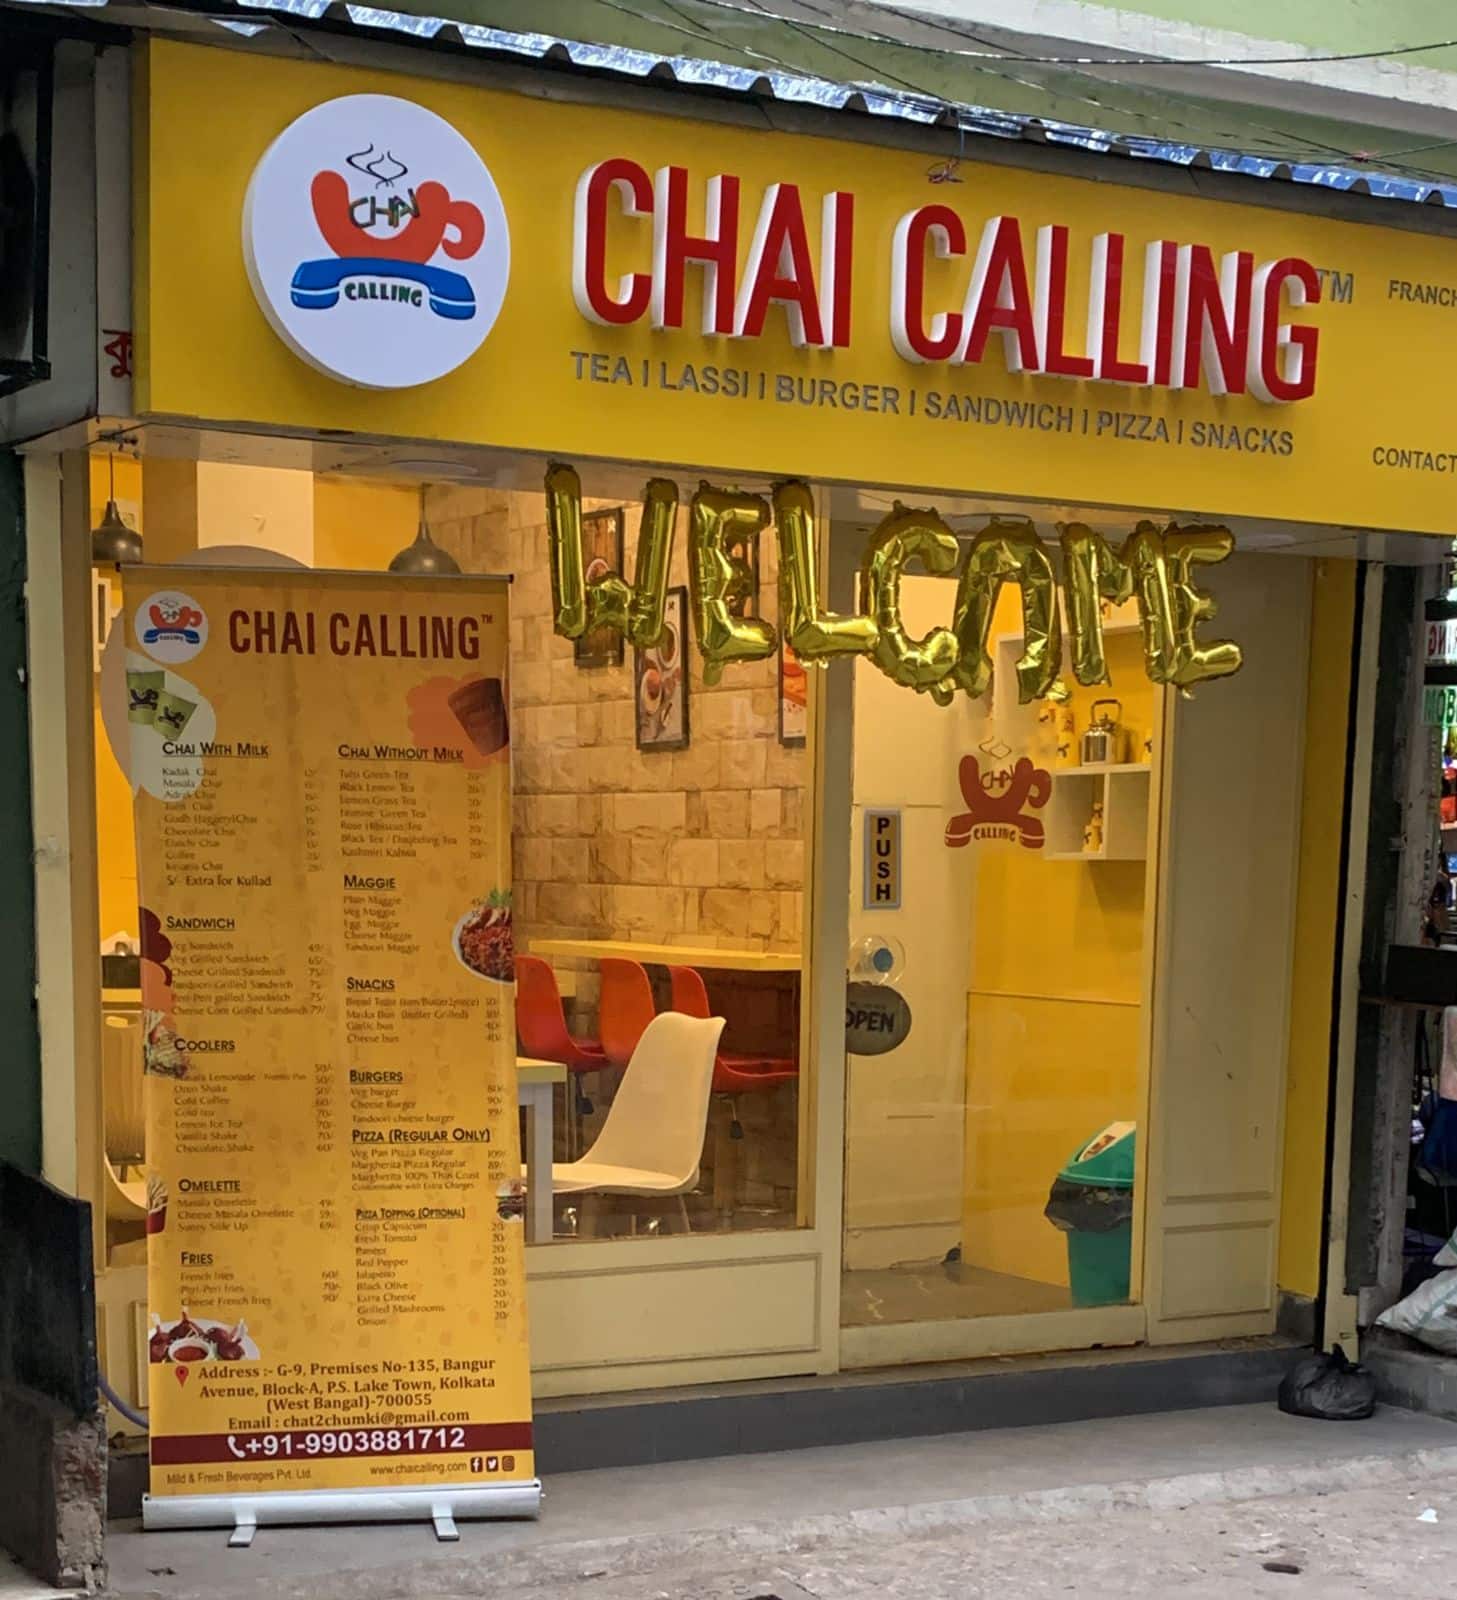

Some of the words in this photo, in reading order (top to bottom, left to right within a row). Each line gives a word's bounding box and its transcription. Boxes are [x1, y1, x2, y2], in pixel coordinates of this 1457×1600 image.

[348, 187, 420, 229] CHAI
[572, 158, 854, 352] CHAI
[890, 204, 1321, 405] CALLING
[1316, 267, 1354, 305] TM
[344, 281, 423, 308] CALLING
[570, 351, 632, 385] TEA
[660, 364, 748, 398] LASSI
[775, 377, 899, 415] BURGER
[924, 396, 1073, 433] SANDWICH
[1097, 409, 1169, 444] PIZZA
[1190, 423, 1294, 457] SNACKS
[544, 461, 1242, 704] WELCOME
[228, 609, 316, 656] CHAI
[329, 612, 481, 660] CALLING
[161, 740, 196, 756] CHAI
[199, 741, 232, 756] WITH
[236, 742, 269, 758] MILK
[338, 743, 371, 759] CHAI
[374, 744, 430, 760] WITHOUT
[433, 746, 465, 762] MILK
[973, 826, 1017, 842] CALLING
[875, 816, 891, 901] PUSH
[186, 875, 214, 887] Extra
[217, 874, 234, 887] for
[343, 873, 397, 889] MAGGIE
[166, 914, 236, 930] SANDWICH
[346, 975, 396, 991] SNACKS
[173, 1037, 237, 1053] COOLERS
[349, 1068, 404, 1084] BURGERS
[352, 1129, 385, 1143] PIZZA
[388, 1129, 449, 1144] (REGULAR
[452, 1127, 491, 1143] ONLY)
[177, 1178, 241, 1193] OMELETTE
[180, 1250, 214, 1265] FRIES
[198, 1364, 260, 1380] Address
[310, 1360, 379, 1376] Premises
[381, 1358, 439, 1375] No-135,
[442, 1357, 497, 1374] Bangur
[199, 1383, 260, 1399] Avenue,
[263, 1380, 324, 1397] Block-A,
[326, 1380, 351, 1394] P.S.
[354, 1378, 389, 1393] Lake
[391, 1377, 437, 1393] Town,
[439, 1375, 497, 1391] Kolkata
[266, 1397, 312, 1413] (West
[314, 1393, 433, 1412] Bangal)-700055
[228, 1416, 272, 1431] Email
[283, 1409, 471, 1429] chat2chumki@gmail.com
[246, 1427, 466, 1457] +91-9903881712
